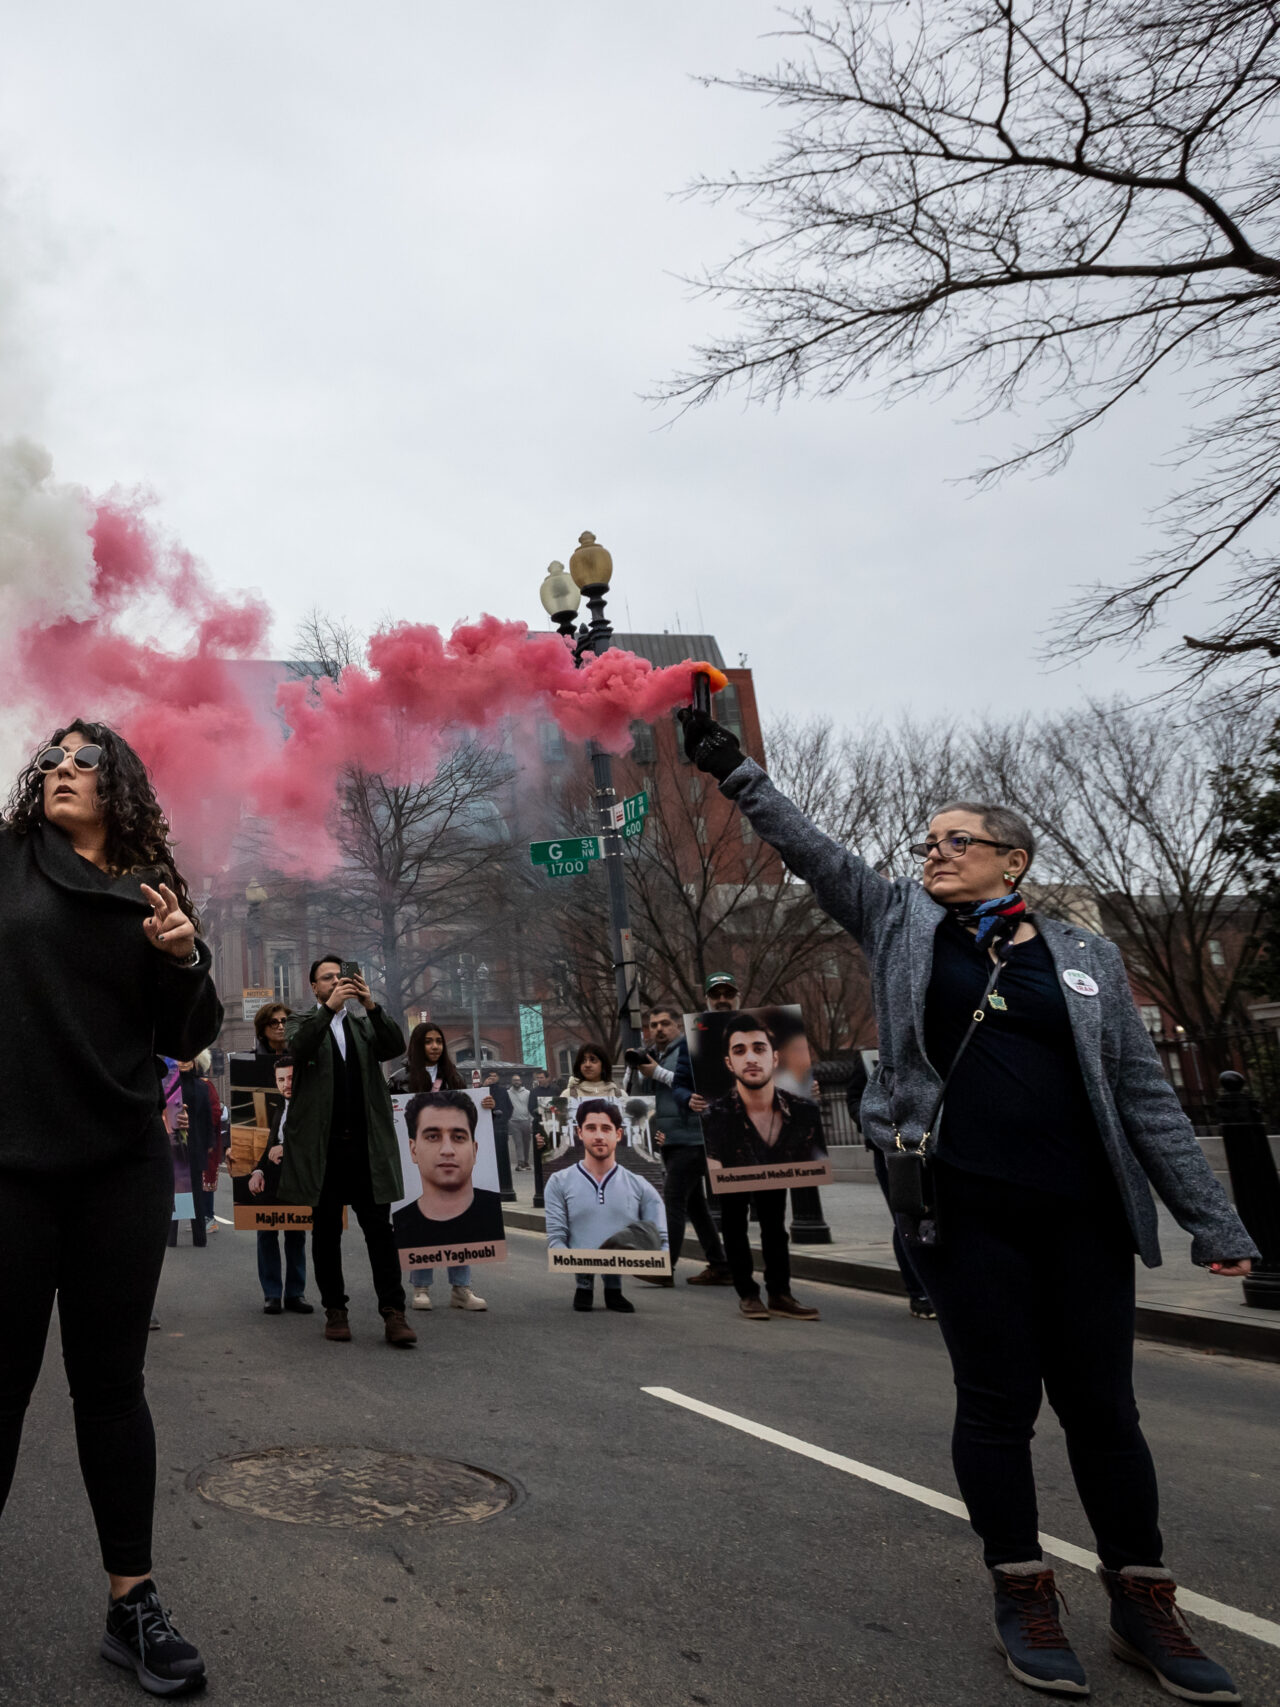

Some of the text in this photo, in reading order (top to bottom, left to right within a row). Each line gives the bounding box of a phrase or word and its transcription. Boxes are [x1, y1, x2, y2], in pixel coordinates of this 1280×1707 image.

[626, 800, 635, 821] 17
[625, 820, 641, 837] 600
[548, 839, 593, 860] G St
[581, 848, 595, 857] NW
[551, 860, 584, 875] 1700
[1075, 984, 1095, 992] IRAN
[717, 1165, 826, 1183] Mohammad Mehdi Karami
[255, 1211, 313, 1227] Majid Kaze
[408, 1245, 496, 1265] Saeed Yaghoubi
[553, 1254, 665, 1268] Mohammad Hosseini
